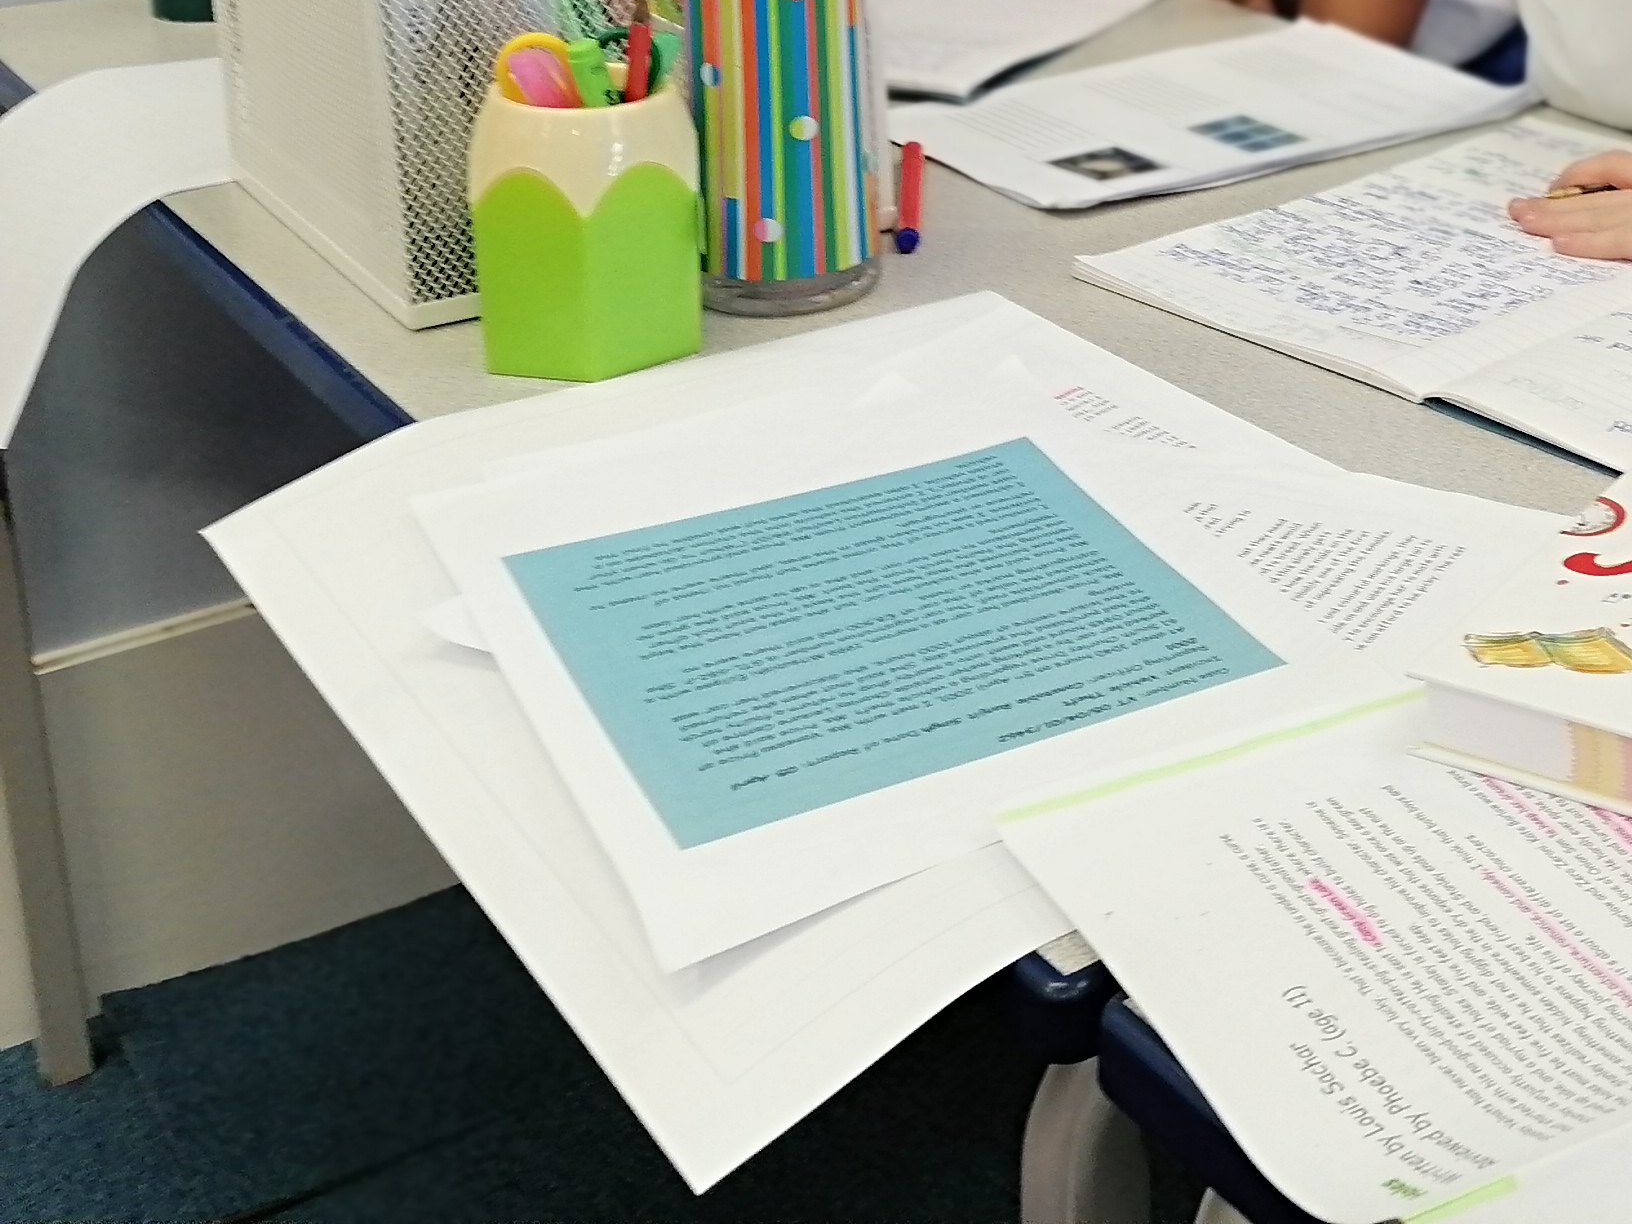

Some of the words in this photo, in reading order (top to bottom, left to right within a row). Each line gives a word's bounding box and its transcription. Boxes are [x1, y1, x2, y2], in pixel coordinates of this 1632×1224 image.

[1281, 985, 1313, 1009] 11)
[1307, 1008, 1347, 1042] (age
[1333, 1040, 1359, 1058] C.
[1289, 1042, 1346, 1095] Sachar
[1352, 1058, 1412, 1116] Phoebe
[1337, 1095, 1385, 1138] Louis
[1403, 1112, 1432, 1134] by
[1376, 1134, 1406, 1156] by
